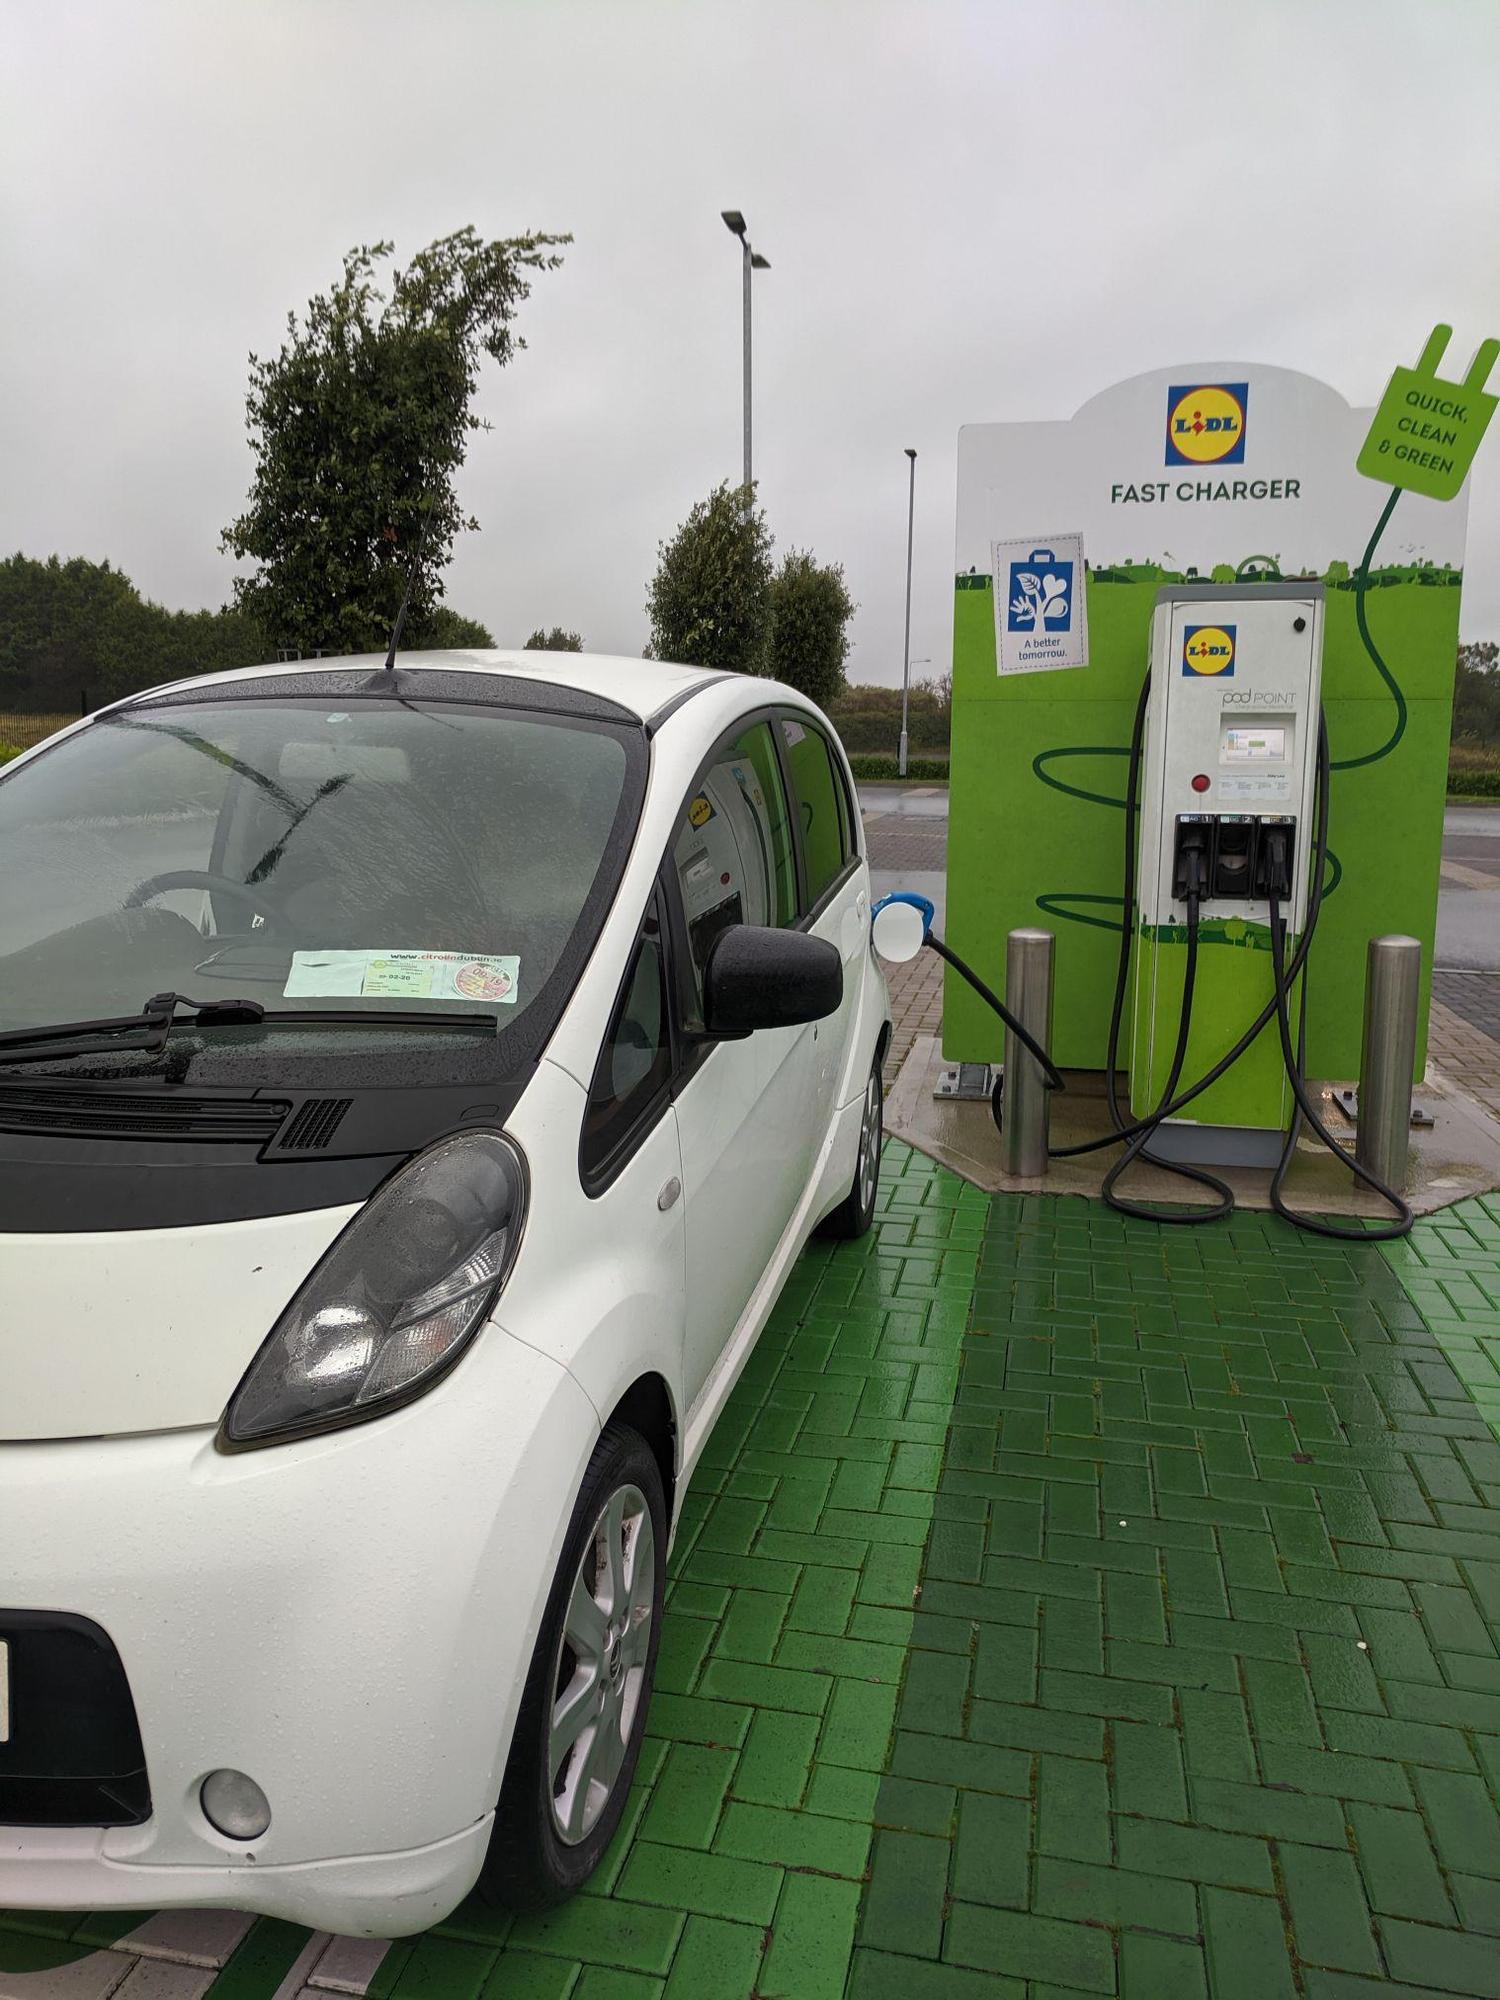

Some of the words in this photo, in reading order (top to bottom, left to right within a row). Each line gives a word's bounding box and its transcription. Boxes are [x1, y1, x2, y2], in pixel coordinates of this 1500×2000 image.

[1406, 391, 1467, 424] QUICK,
[1398, 417, 1457, 447] CLEAN
[1378, 439, 1391, 454] &
[1394, 445, 1454, 474] GREEN
[1111, 483, 1170, 503] FAST
[1176, 479, 1301, 502] CHARGER
[1024, 639, 1031, 648] A
[1033, 637, 1061, 648] better
[1018, 649, 1068, 661] tomorrow.
[1222, 688, 1252, 708] pod
[1253, 692, 1297, 704] POINT
